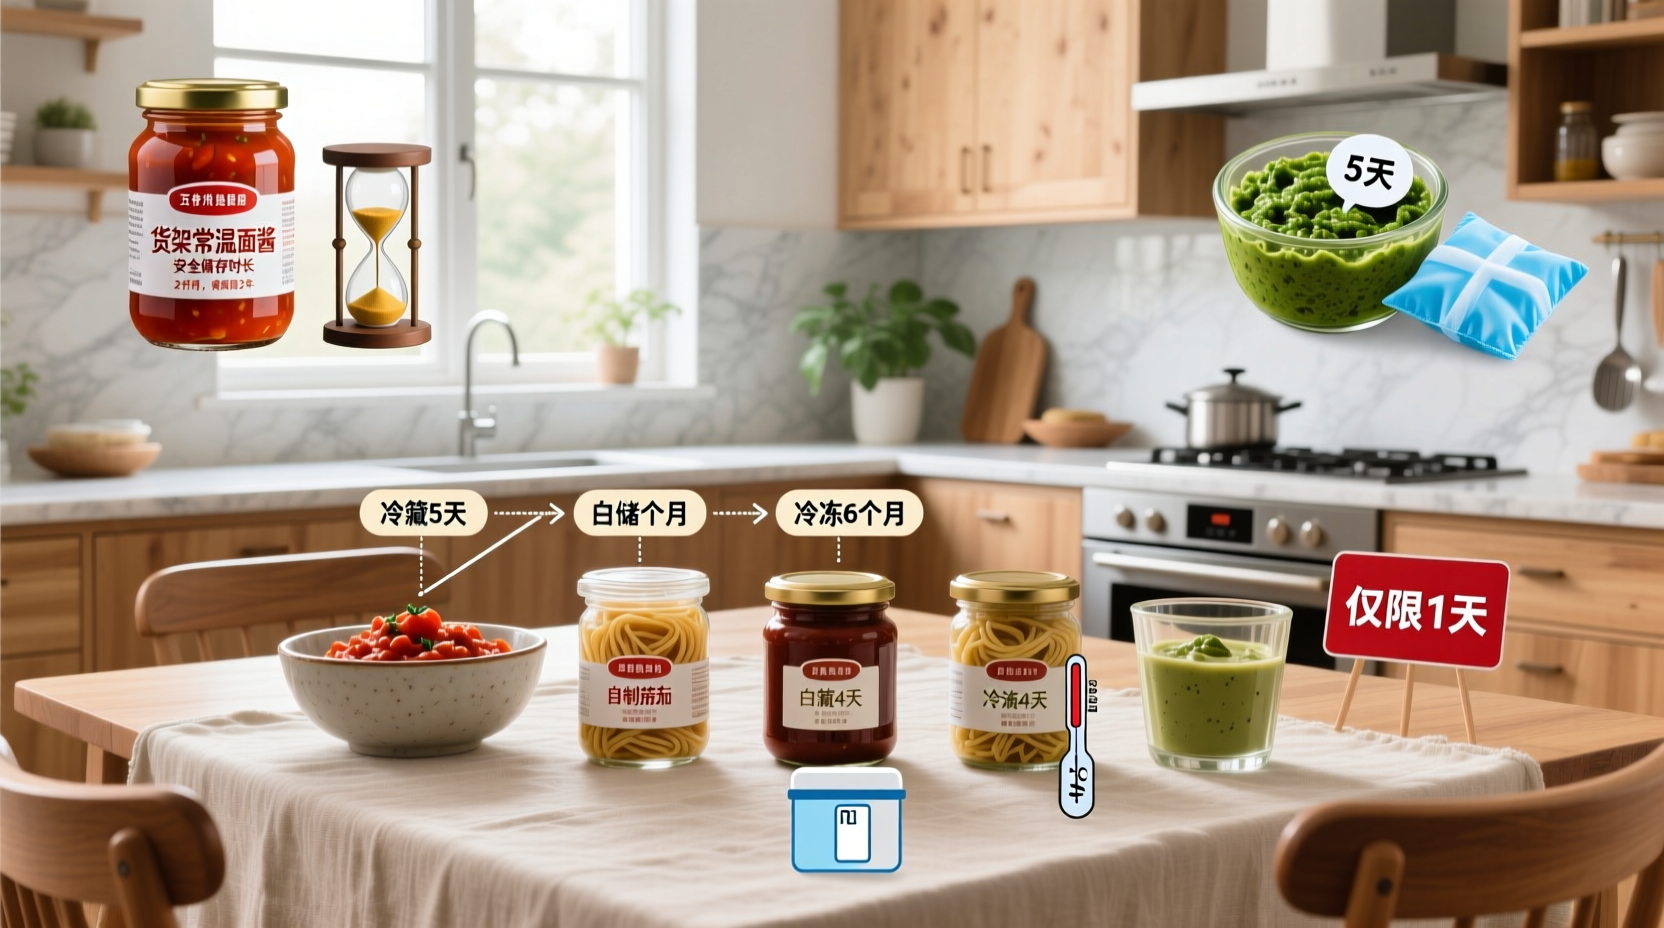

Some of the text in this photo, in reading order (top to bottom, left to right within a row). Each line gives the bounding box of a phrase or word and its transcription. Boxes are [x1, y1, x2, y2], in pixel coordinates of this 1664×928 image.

[150, 225, 276, 254] 货架常温面酱
[1345, 584, 1488, 637] 仅限1天
